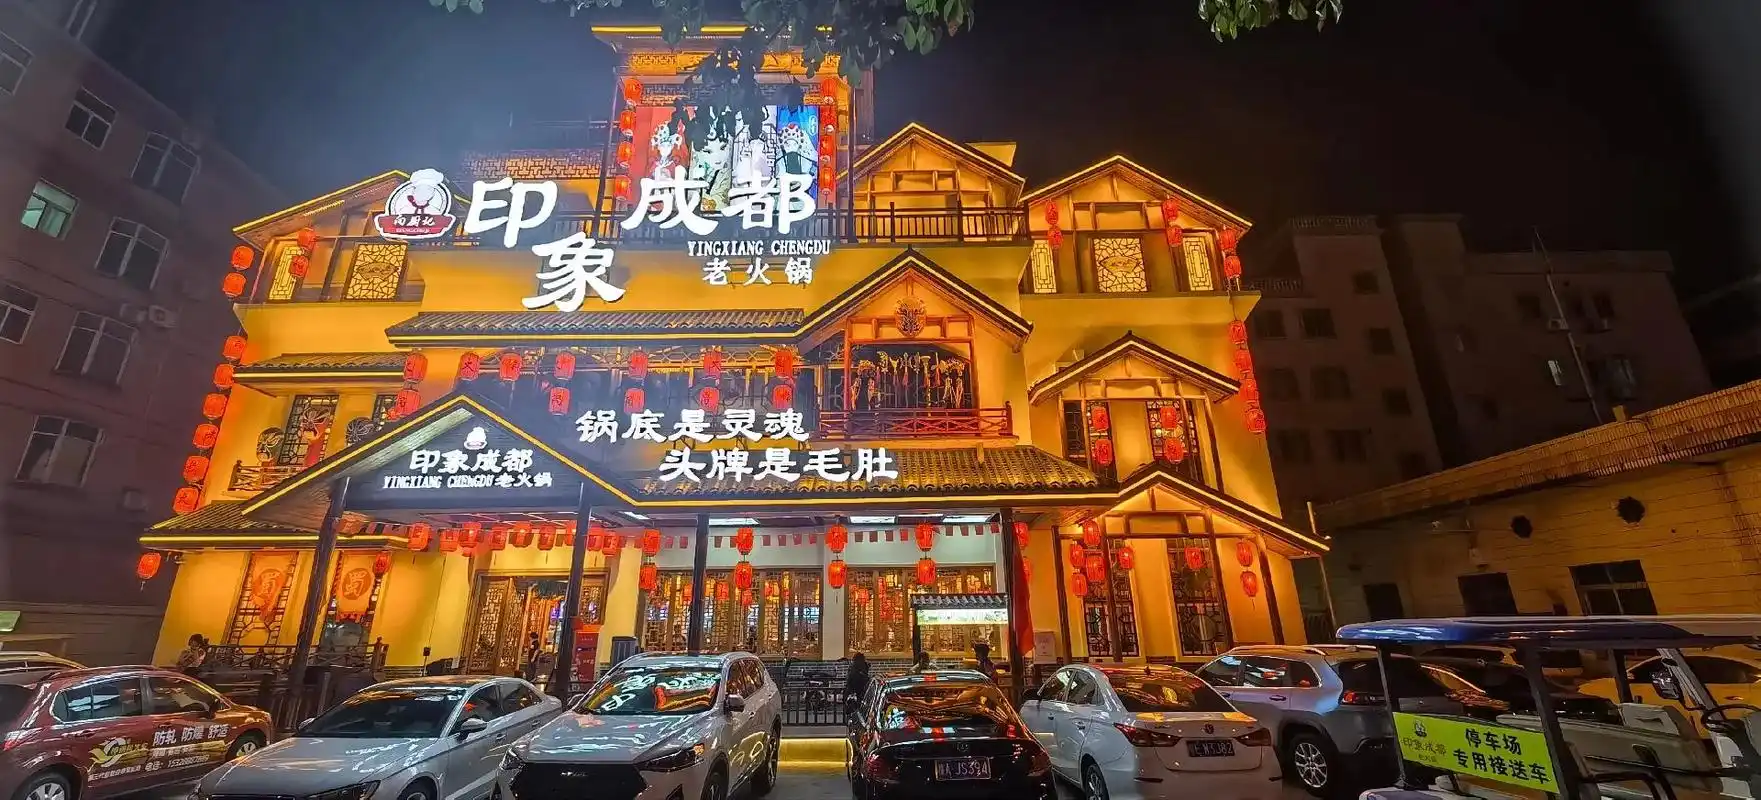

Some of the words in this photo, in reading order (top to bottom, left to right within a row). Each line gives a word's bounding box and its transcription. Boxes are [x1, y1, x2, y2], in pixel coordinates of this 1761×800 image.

[688, 240, 765, 257] YINGXIANG
[771, 240, 831, 256] CHENGDU
[702, 257, 814, 286] 老火锅
[576, 408, 811, 443] 锅底是灵魂
[409, 448, 534, 474] 印象成都
[659, 447, 899, 483] 头牌是毛肚
[382, 475, 443, 489] YINGXIANG
[447, 474, 494, 489] CHENGDU
[495, 471, 553, 488] 老火锅
[343, 568, 367, 597] 蜀
[1401, 738, 1447, 755] 印象成都
[1465, 727, 1522, 756] 停车场
[1452, 748, 1551, 785] 专用接送车
